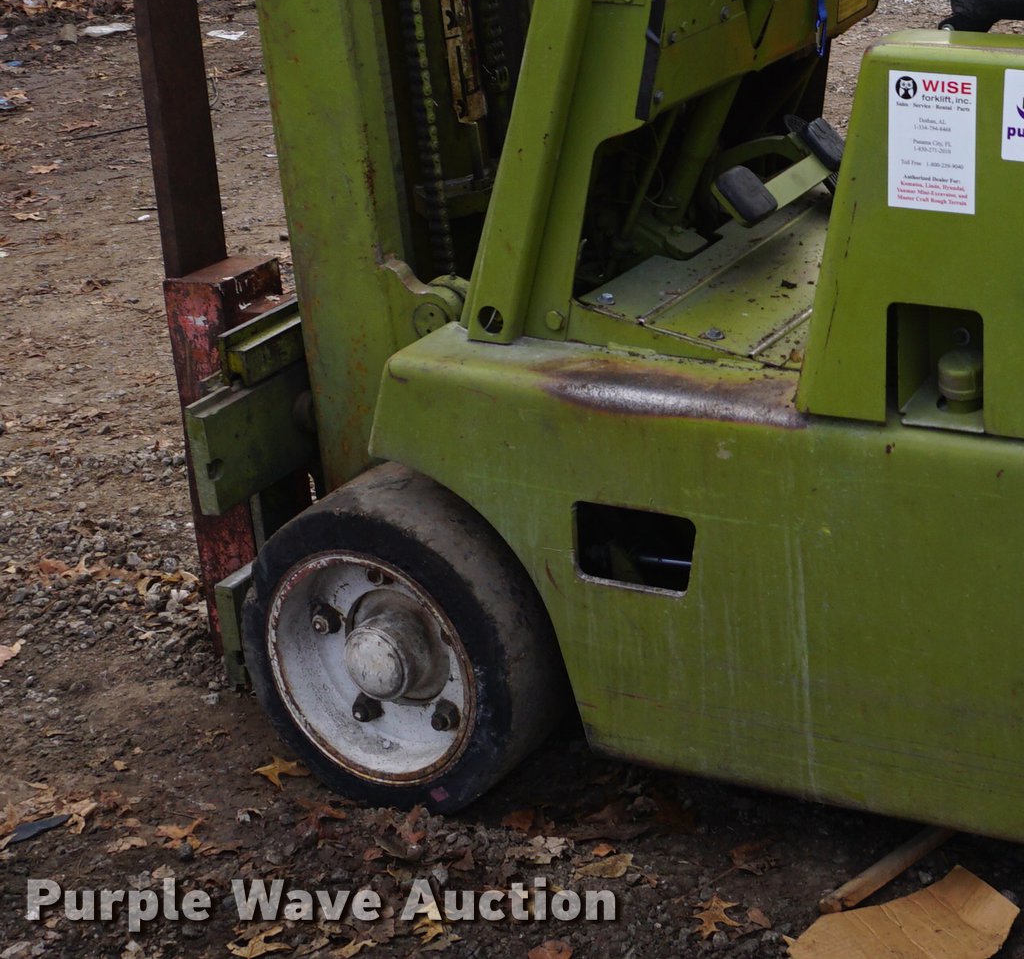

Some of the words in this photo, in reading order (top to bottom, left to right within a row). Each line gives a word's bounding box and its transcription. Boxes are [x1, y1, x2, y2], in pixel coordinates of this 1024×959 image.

[922, 78, 972, 95] WISE
[921, 94, 955, 105] forklift,
[955, 96, 972, 105] inc.
